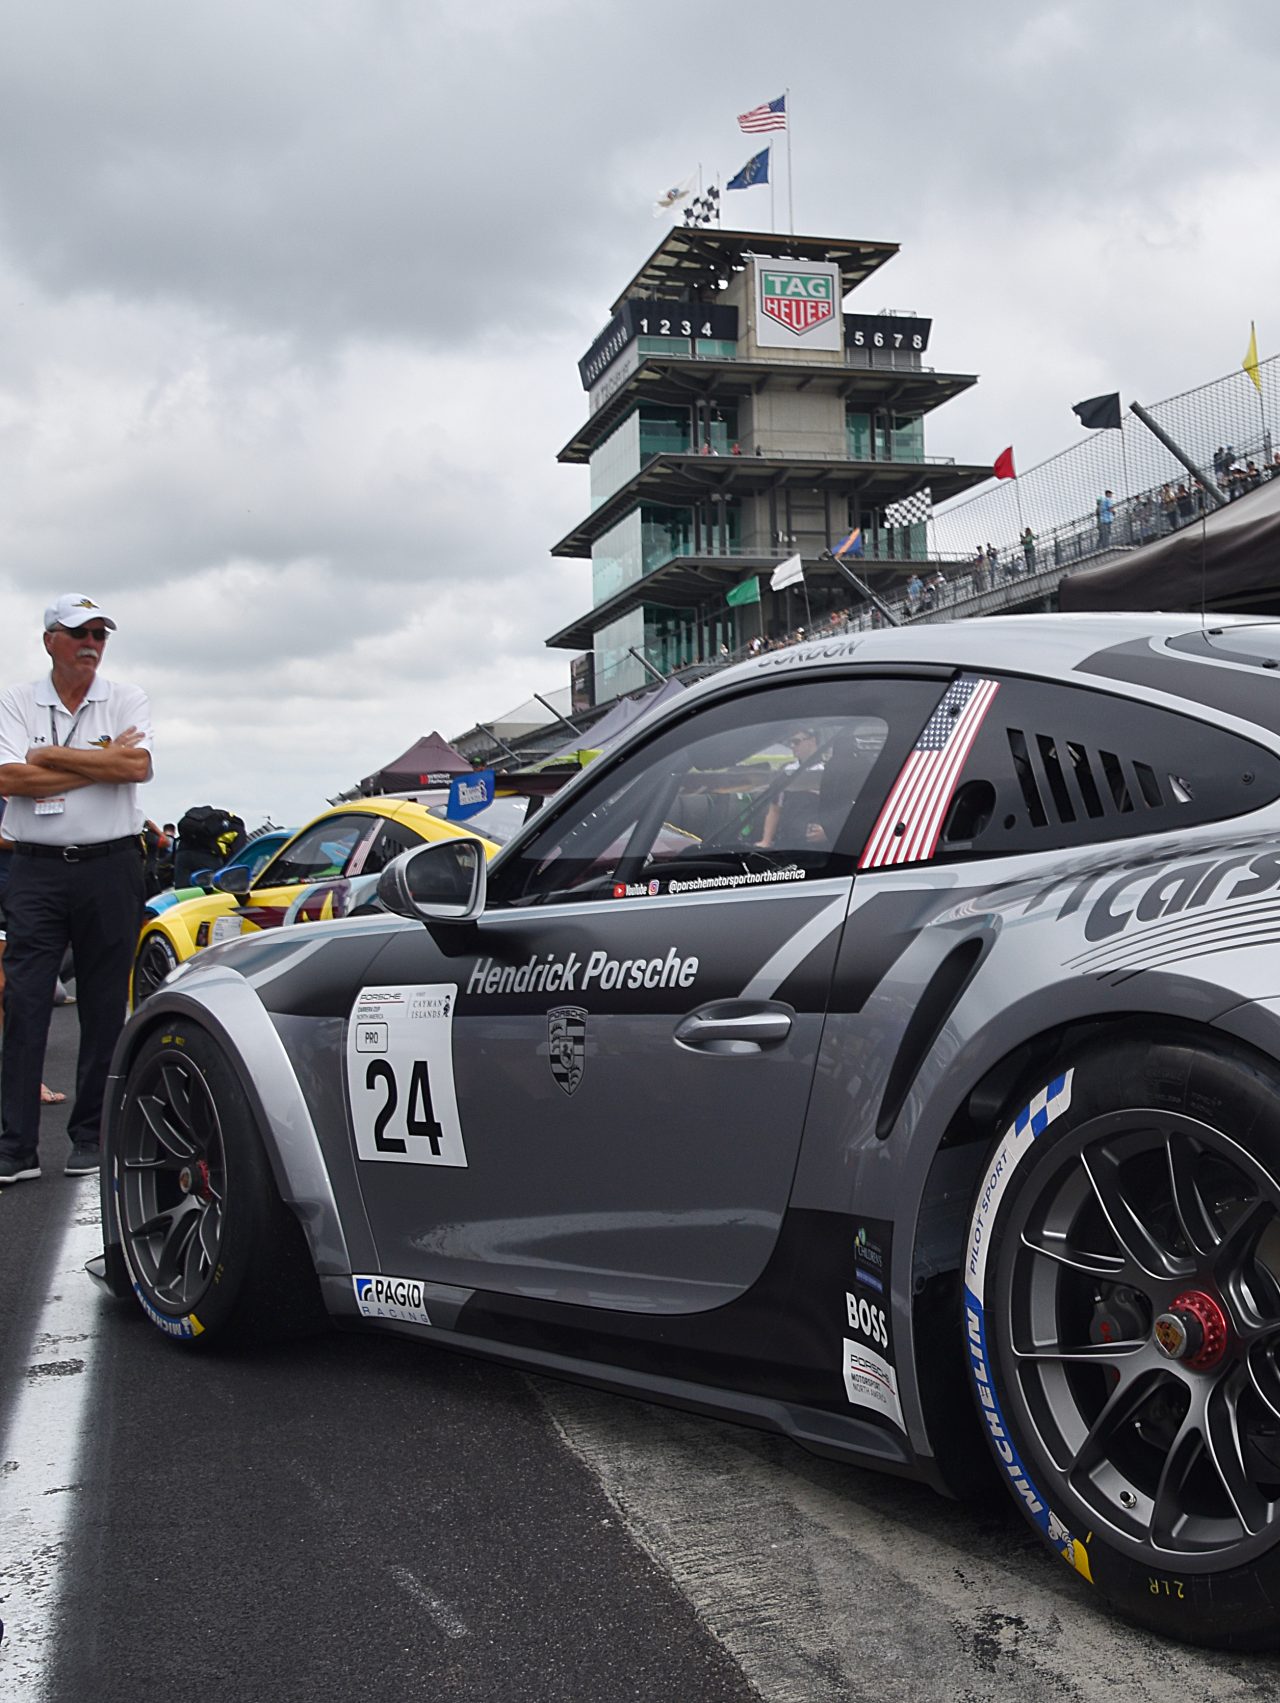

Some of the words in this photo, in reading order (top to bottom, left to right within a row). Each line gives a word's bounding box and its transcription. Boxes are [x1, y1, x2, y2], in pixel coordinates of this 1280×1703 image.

[767, 276, 827, 298] TAG
[766, 299, 830, 328] HEUER
[640, 318, 648, 333] 1
[660, 319, 671, 335] 2
[681, 320, 692, 336] 3
[701, 322, 712, 337] 4
[854, 331, 865, 346] 5
[873, 332, 884, 347] 6
[893, 334, 904, 348] 7
[912, 334, 923, 349] 8
[625, 884, 648, 896] YouTube
[668, 869, 806, 894] @porschemotorsportnorthamerica
[466, 952, 582, 995] Hendrick
[581, 946, 700, 990] Porsche
[359, 992, 403, 1001] PORSCHE
[412, 1000, 442, 1008] CAYMAN
[411, 1011, 441, 1019] ISLANDS
[365, 1031, 379, 1044] PRO
[365, 1058, 444, 1157] 24
[969, 1213, 985, 1276] PILOT
[981, 1147, 1008, 1214] SPORT
[375, 1279, 422, 1309] PAGID
[361, 1306, 429, 1323] RACING
[845, 1291, 888, 1349] BOSS
[966, 1307, 1044, 1514] MICHELIN
